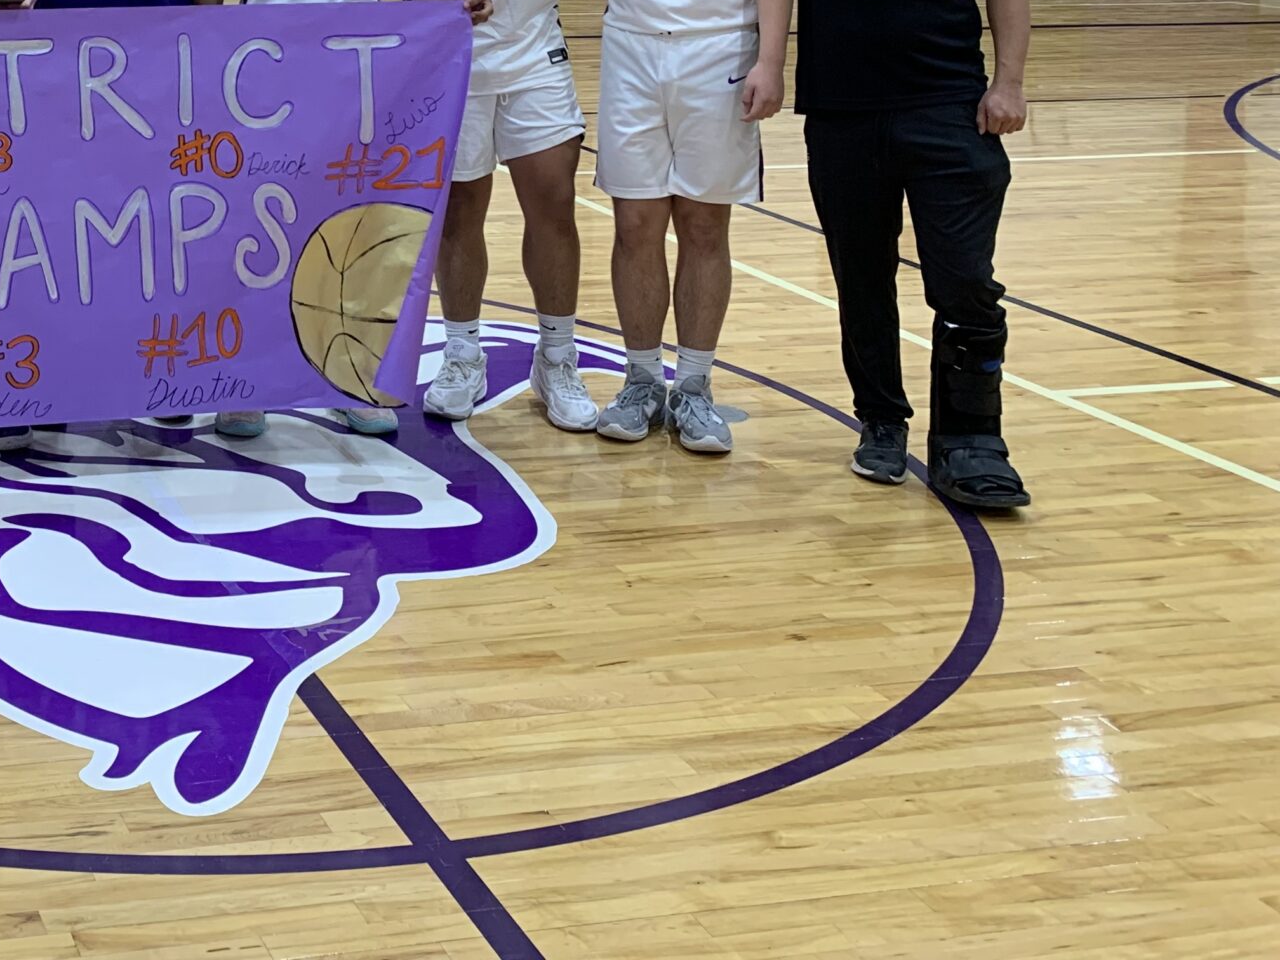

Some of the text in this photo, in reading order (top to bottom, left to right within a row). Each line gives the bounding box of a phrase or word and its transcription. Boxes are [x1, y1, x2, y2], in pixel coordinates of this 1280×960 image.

[384, 91, 446, 144] Luis
[170, 129, 244, 179] #0
[247, 151, 310, 178] Derick
[324, 136, 446, 196] #21
[137, 307, 244, 378] #10
[147, 372, 255, 411] Dustin
